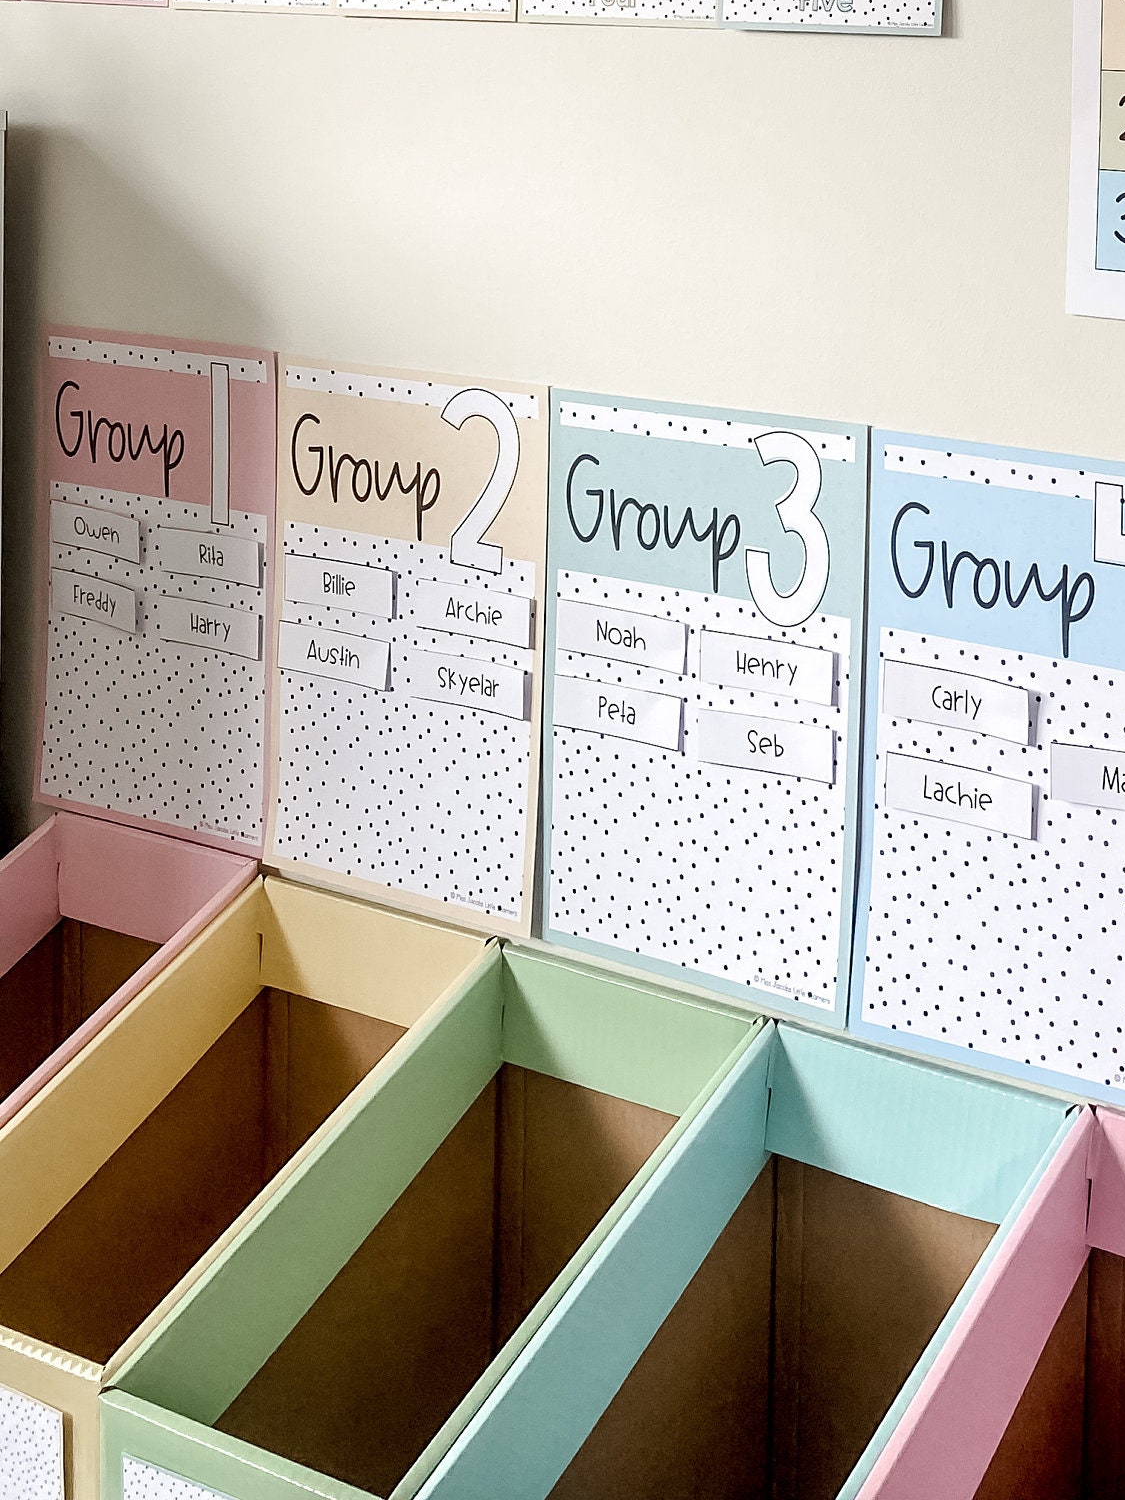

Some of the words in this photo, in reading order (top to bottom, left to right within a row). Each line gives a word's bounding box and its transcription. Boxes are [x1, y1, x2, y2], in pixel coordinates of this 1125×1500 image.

[55, 380, 185, 497] Group
[210, 362, 230, 526] 1
[291, 413, 441, 541] Group
[441, 388, 520, 575] 2
[73, 516, 120, 544] Owen
[565, 454, 741, 592] Group
[745, 430, 830, 627] 3
[199, 545, 224, 567] Rita
[323, 572, 356, 597] Billie
[892, 502, 1096, 658] Group
[73, 586, 116, 617] Freddy
[445, 598, 503, 626] Archie
[190, 615, 231, 642] Harry
[596, 623, 646, 651] Noah
[307, 641, 360, 669] Austin
[736, 651, 798, 686] Henry
[437, 667, 500, 699] Skyelar
[598, 696, 637, 726] Peta
[932, 687, 982, 720] Carly
[747, 731, 784, 759] Seb
[922, 774, 993, 811] Lachie
